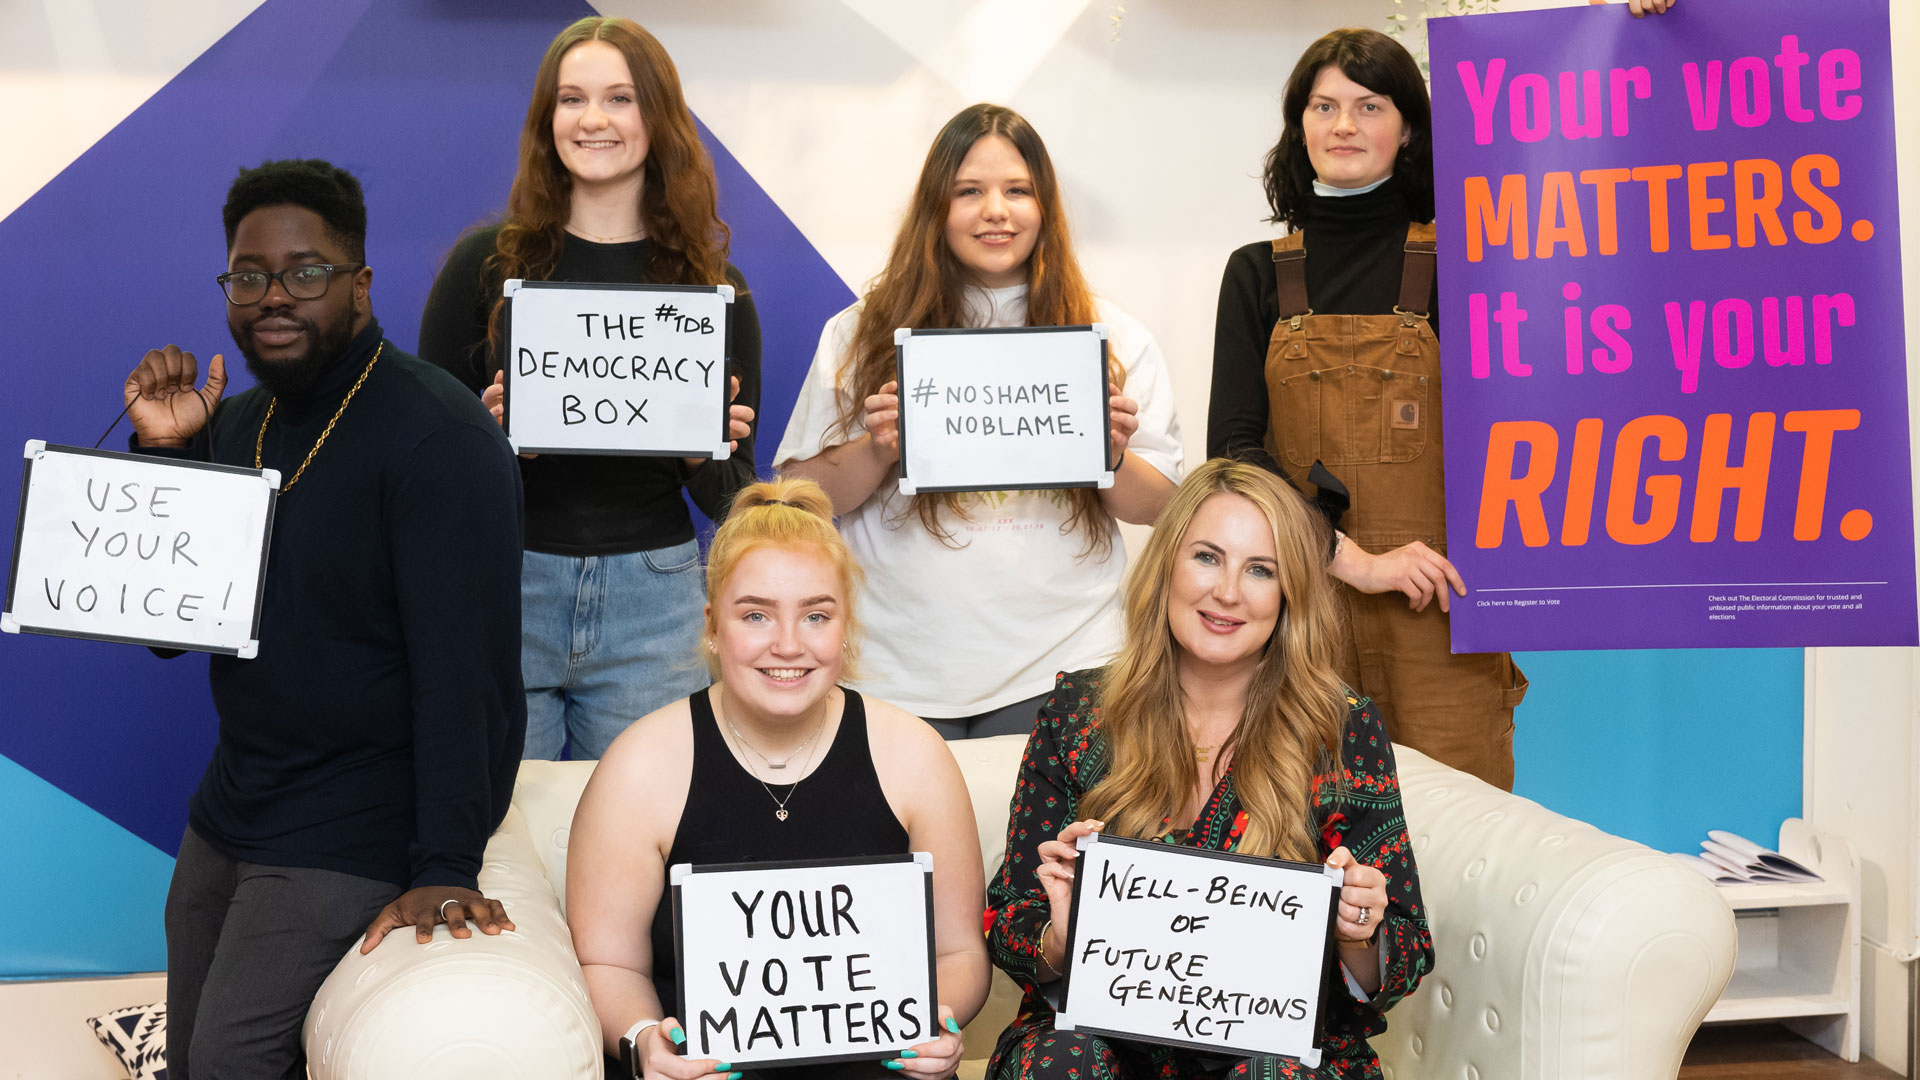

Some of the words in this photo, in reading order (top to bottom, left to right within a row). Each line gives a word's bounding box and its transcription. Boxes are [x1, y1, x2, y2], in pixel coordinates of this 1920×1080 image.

[1457, 58, 1652, 145] Your
[1682, 34, 1863, 131] vote
[1464, 153, 1875, 263] MATTERS.
[576, 313, 646, 341] THE
[654, 303, 715, 335] #TDB
[1468, 291, 1533, 379] It
[1562, 281, 1633, 375] is
[1664, 292, 1856, 394] your
[518, 346, 716, 388] DEMOCRACY
[562, 394, 649, 426] BOX
[86, 477, 182, 518] USE
[1475, 408, 1874, 550] RIGHT.
[71, 520, 199, 567] YOUR
[44, 576, 233, 626] VOICE!
[1513, 599, 1538, 607] Register
[1708, 613, 1736, 621] elections
[1737, 604, 1755, 612] public
[1811, 604, 1826, 612] your
[731, 883, 861, 940] YOUR
[1170, 914, 1210, 934] OF
[718, 953, 877, 997] VOTE
[1081, 938, 1209, 982] FUTURE
[1108, 974, 1308, 1021] GENERATIONS
[699, 997, 922, 1055] MATTERS
[1172, 1009, 1245, 1041] ACT
